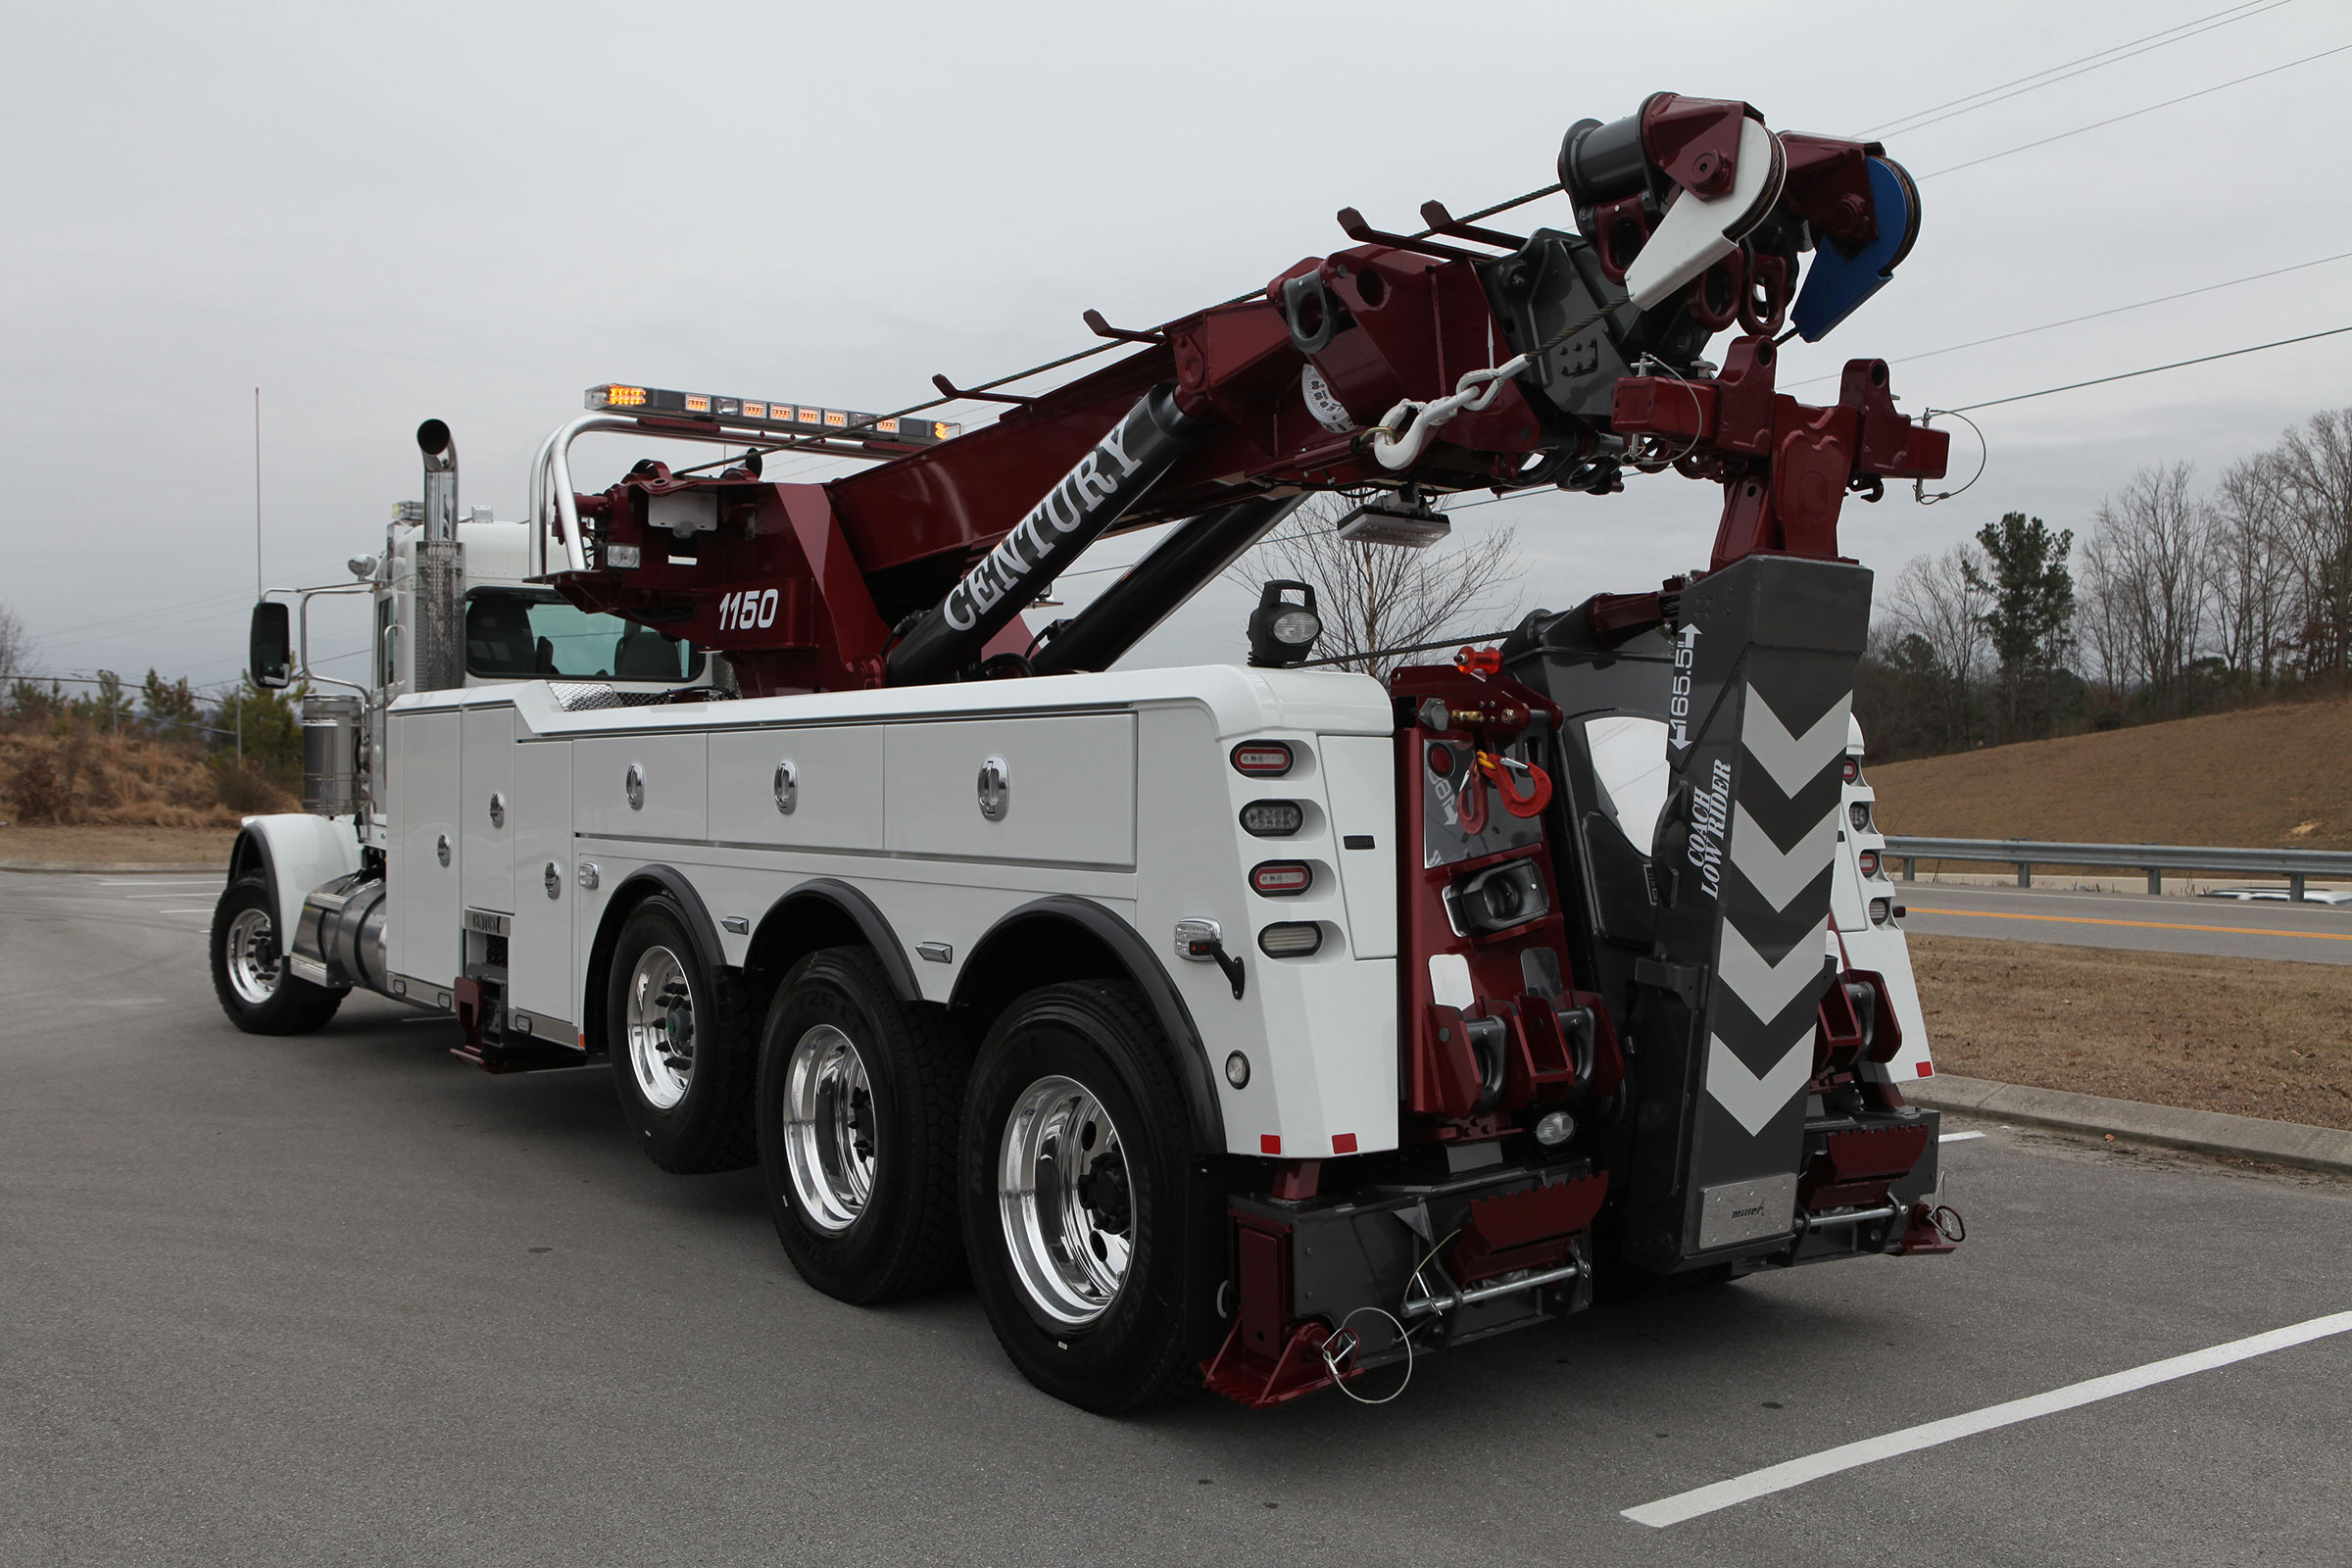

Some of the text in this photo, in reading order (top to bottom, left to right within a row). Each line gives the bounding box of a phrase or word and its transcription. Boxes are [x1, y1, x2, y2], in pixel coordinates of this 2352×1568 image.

[944, 415, 1143, 631] CENTURY
[719, 588, 779, 630] 1150
[1687, 786, 1711, 867] COACH
[1701, 759, 1732, 901] LOW RIDER
